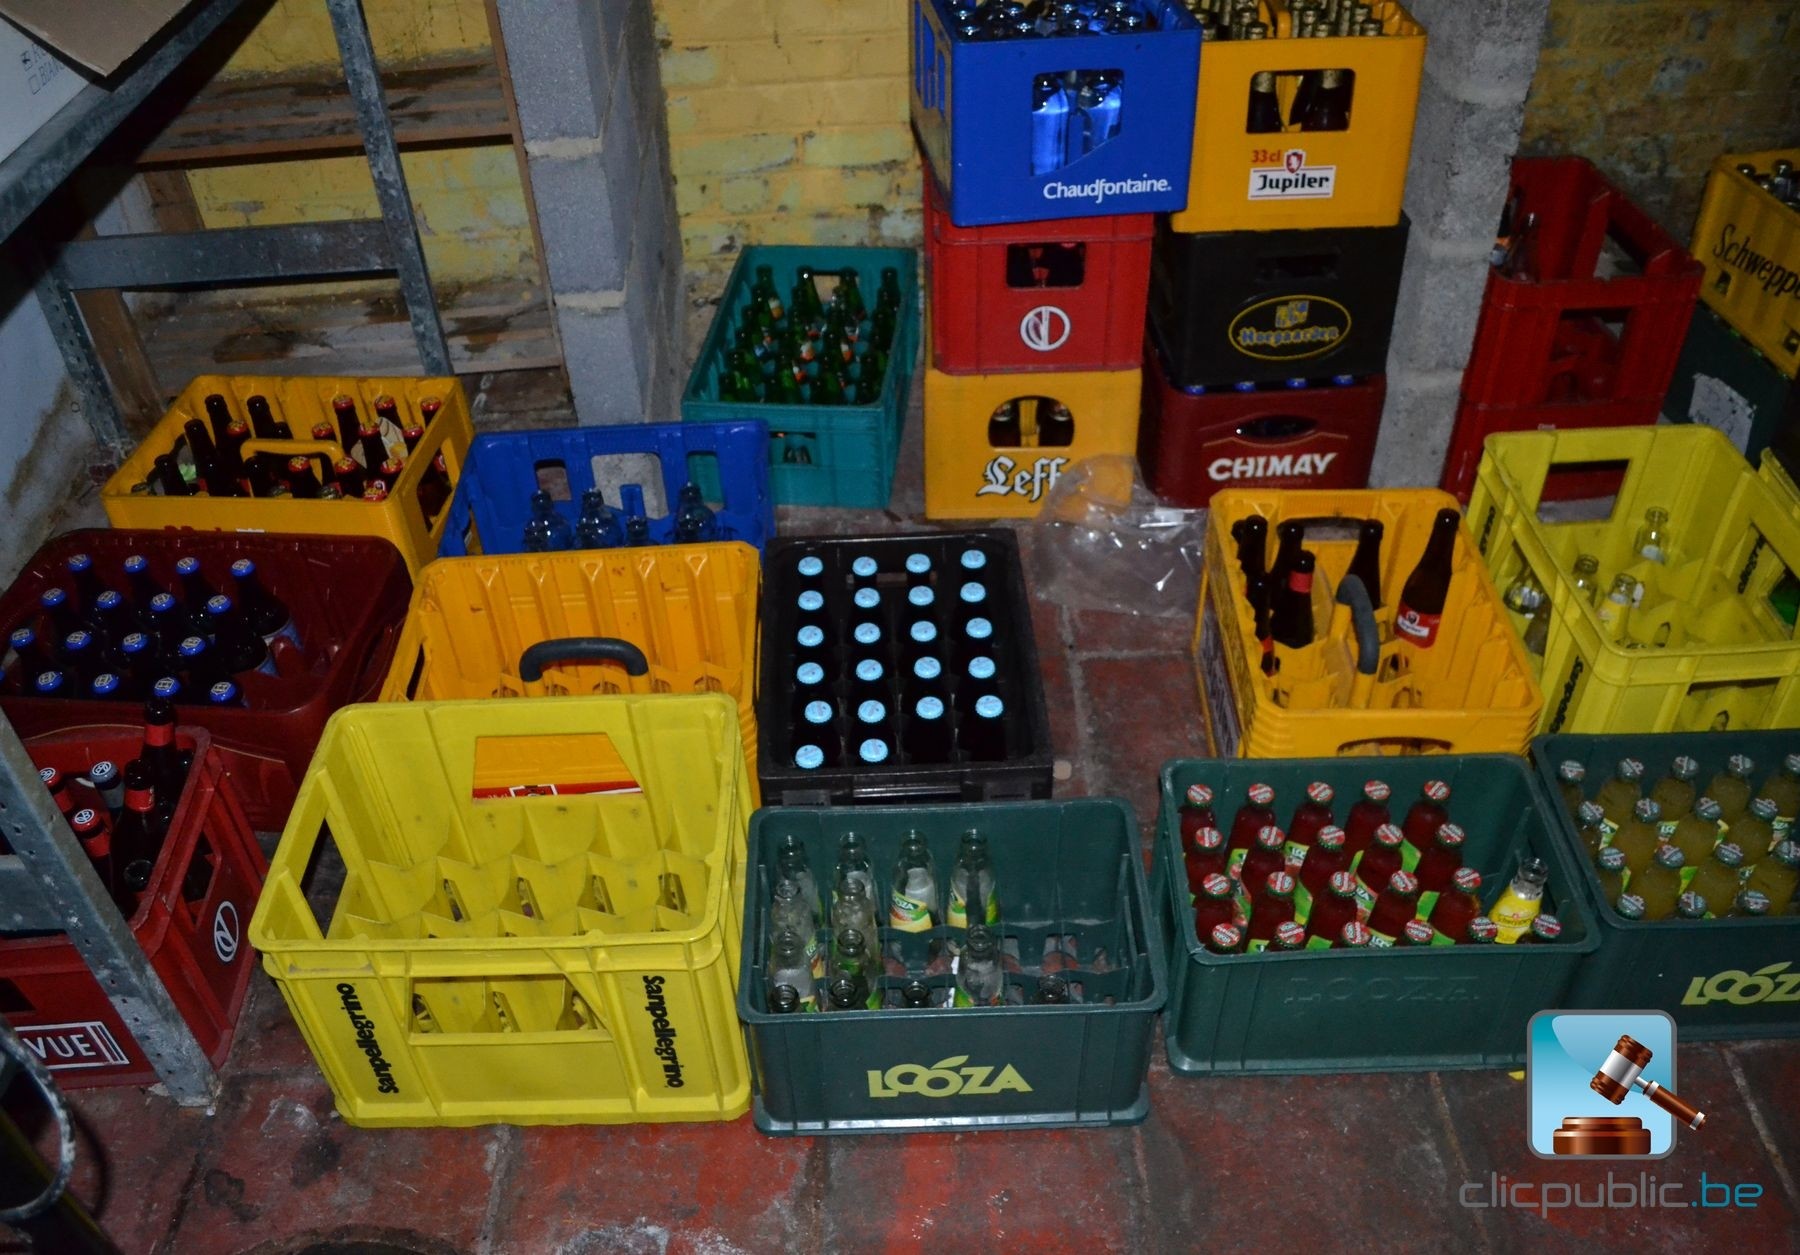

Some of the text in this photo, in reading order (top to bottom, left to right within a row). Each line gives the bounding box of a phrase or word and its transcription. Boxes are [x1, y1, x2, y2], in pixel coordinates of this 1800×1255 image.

[1252, 149, 1281, 163] 33cl
[1043, 173, 1169, 203] Chaudfontaine
[1256, 173, 1330, 193] Jupiler
[1207, 452, 1338, 481] CHIMAY
[336, 983, 399, 1094] Sanpellegrino
[642, 975, 684, 1088] Sanpellegrino
[22, 1034, 97, 1059] VUE
[867, 1055, 1033, 1098] LOOZA
